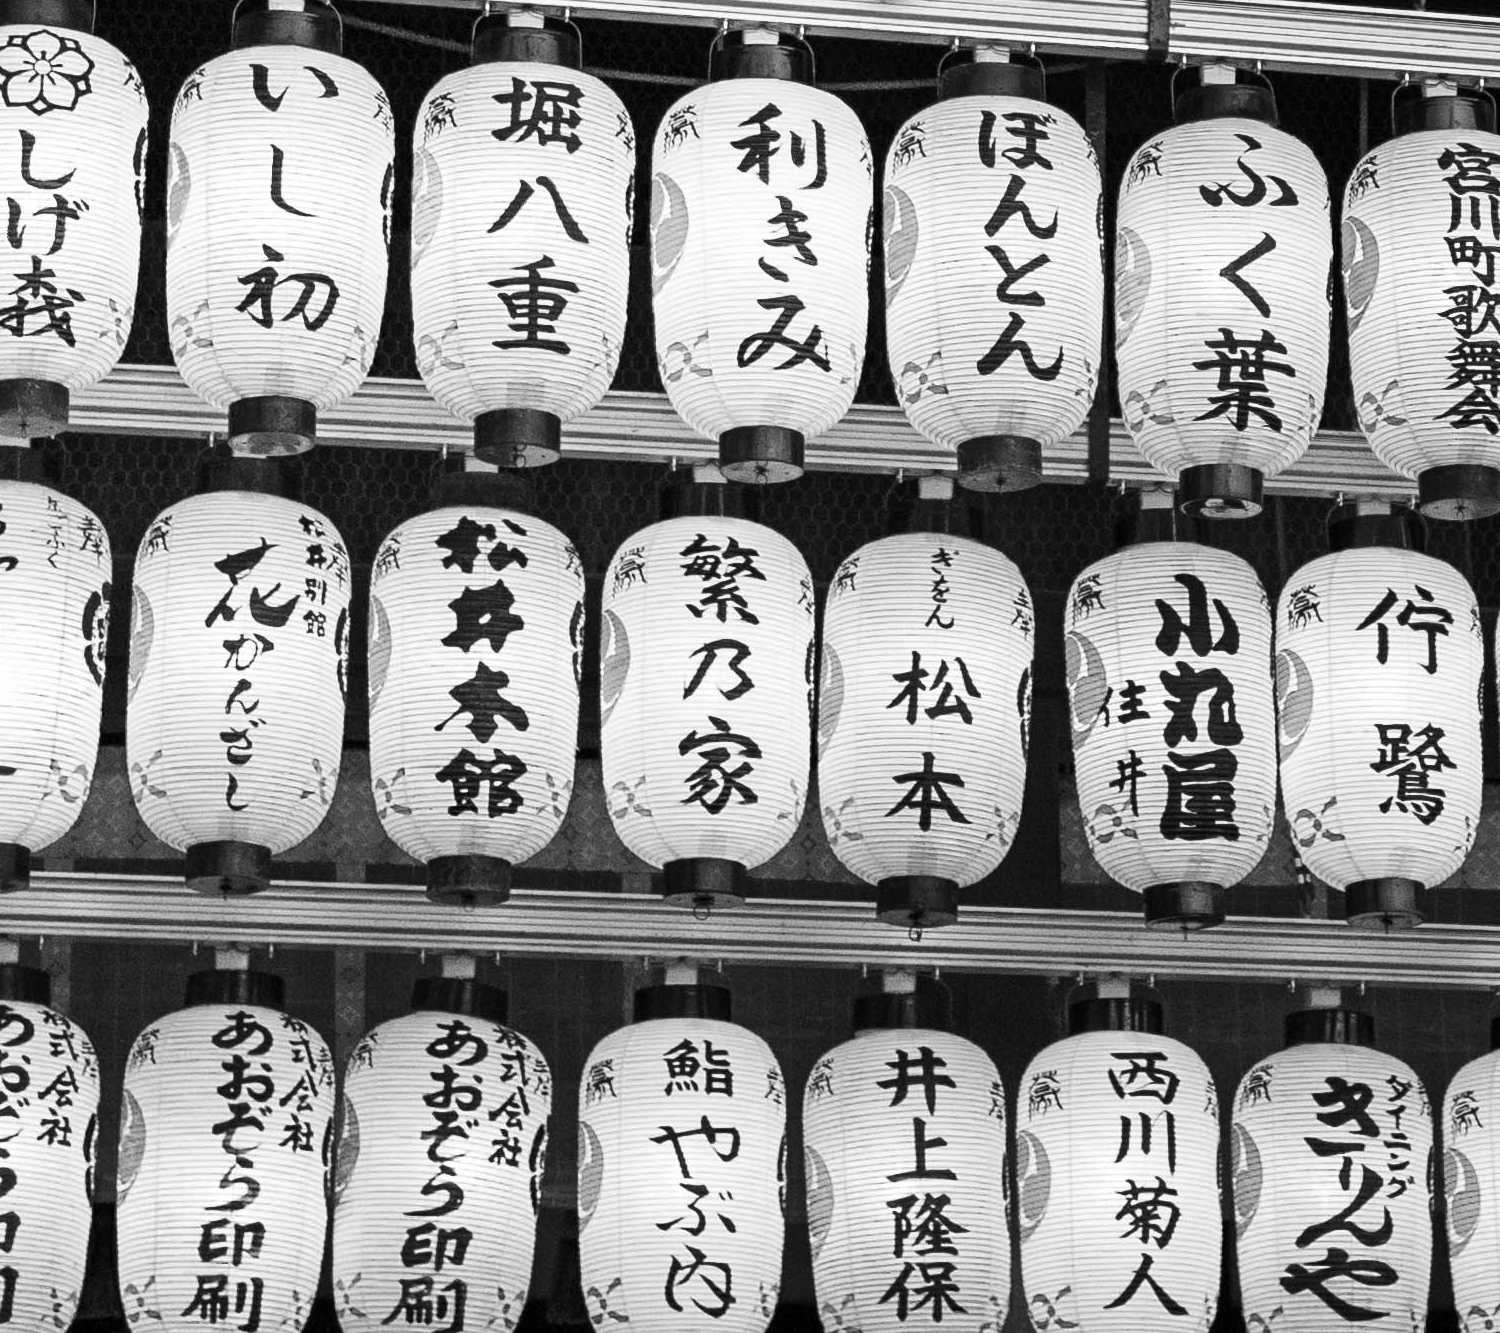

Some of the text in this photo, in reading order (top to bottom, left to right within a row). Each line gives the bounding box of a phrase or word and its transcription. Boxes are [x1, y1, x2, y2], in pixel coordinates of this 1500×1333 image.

[235, 64, 340, 331] いし初
[488, 77, 588, 355] 堀八重
[731, 103, 831, 372] 利きみ
[1192, 134, 1298, 433] ふく葉
[435, 516, 529, 818] 松井本館
[679, 534, 766, 814] 繁乃家
[884, 651, 981, 832] 松本
[180, 1011, 274, 1333] あおぞら印刷
[381, 1020, 488, 1333] あおぞら印刷
[876, 1046, 970, 1322] 井上隆保
[1104, 1052, 1188, 1315] 西川菊人
